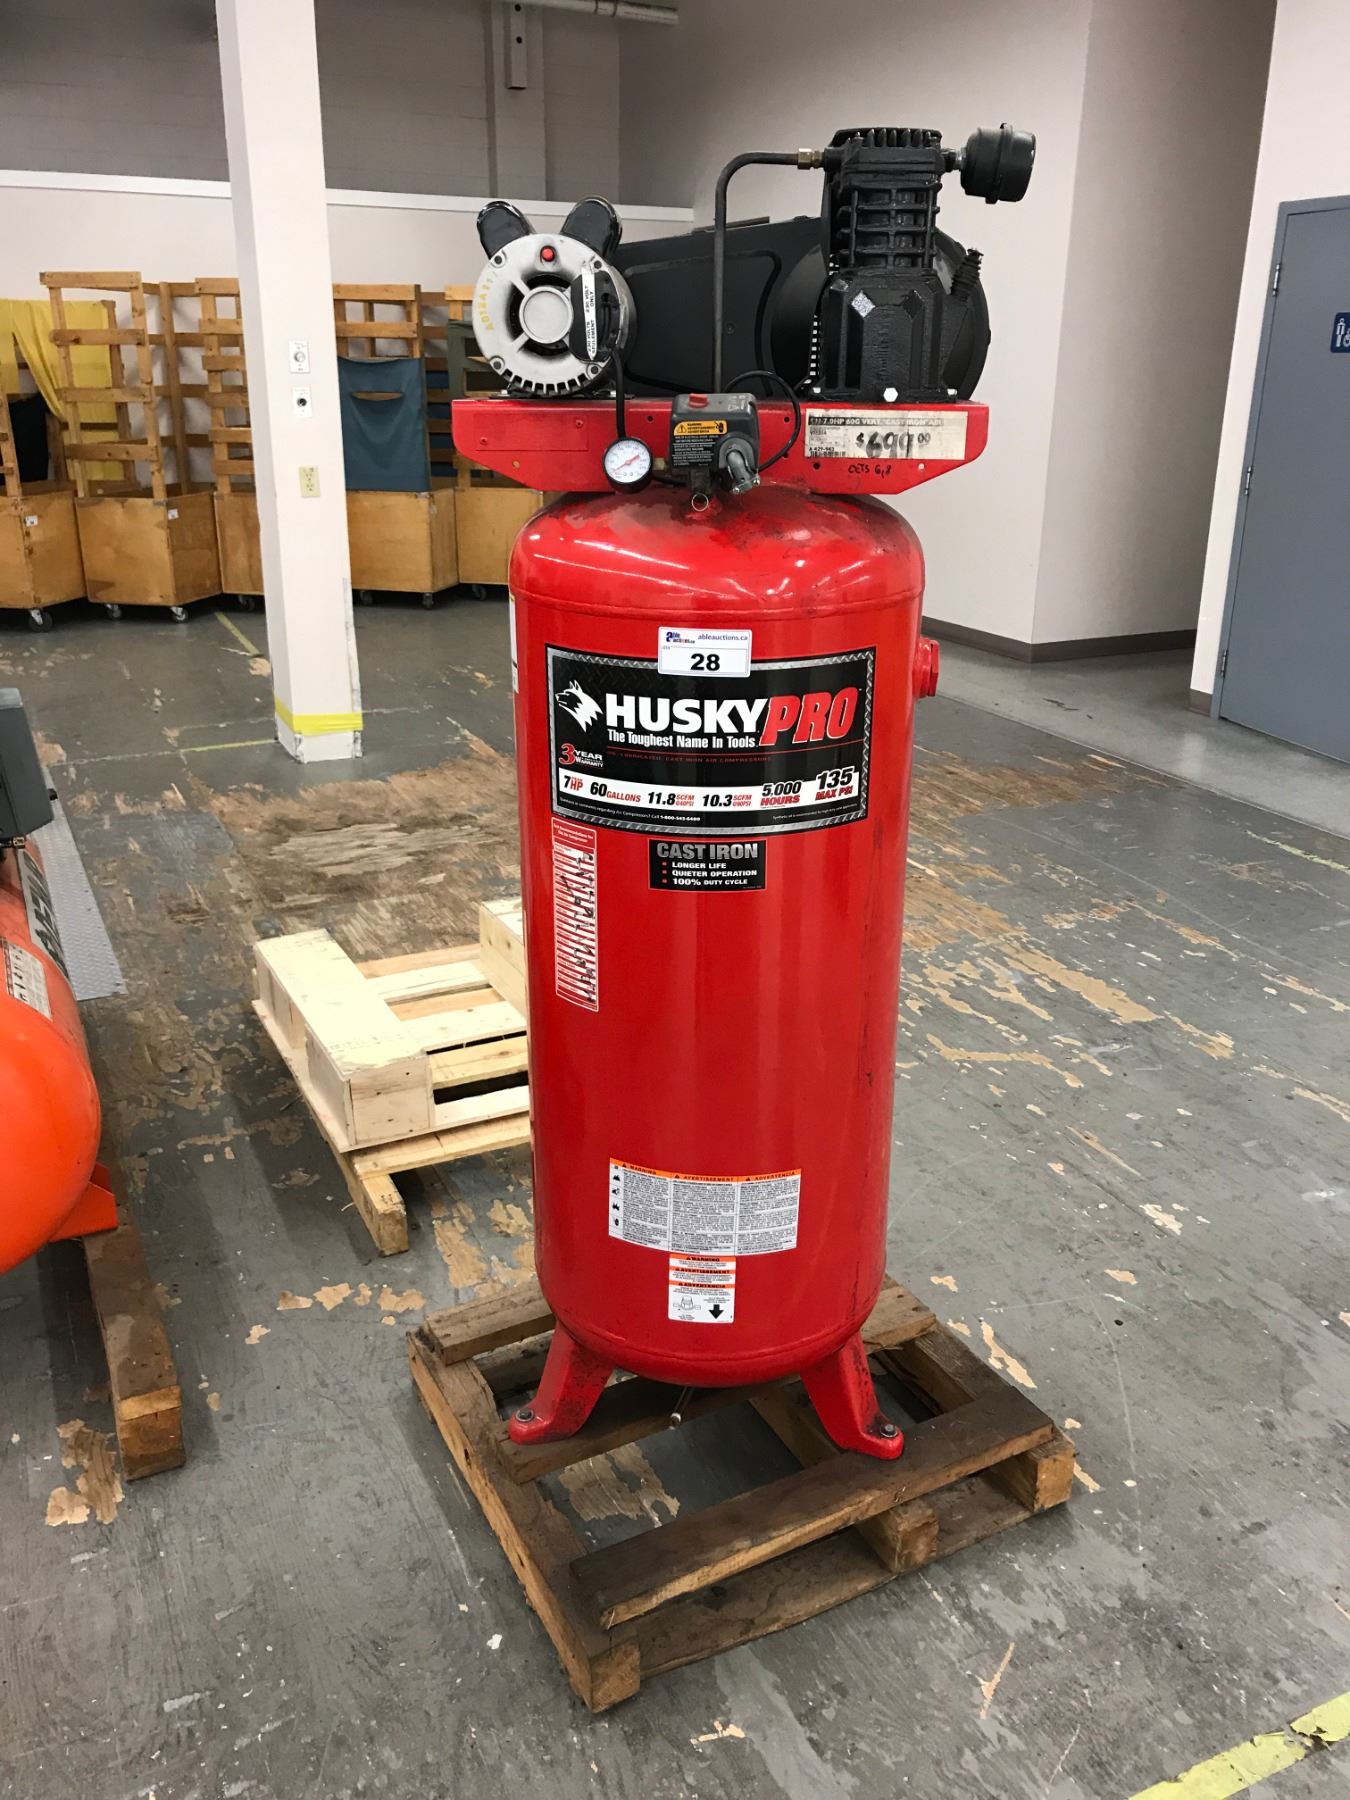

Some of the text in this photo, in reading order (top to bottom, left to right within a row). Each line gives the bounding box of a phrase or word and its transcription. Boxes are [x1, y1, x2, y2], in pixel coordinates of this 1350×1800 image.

[690, 653, 720, 672] 28
[606, 686, 859, 746] HUSKY PRO
[608, 728, 626, 743] The
[627, 731, 674, 748] Toughest
[676, 736, 708, 748] Name
[712, 736, 724, 748] In
[558, 742, 602, 764] 3 YEAR
[575, 756, 604, 768] WARRANTY
[818, 766, 854, 790] 135
[564, 775, 571, 788] 7
[570, 779, 583, 790] HP
[590, 782, 608, 797] 60
[607, 790, 641, 802] GALLONS
[648, 792, 676, 806] 11.8
[702, 794, 732, 807] 10.3
[762, 782, 802, 796] 5,000
[815, 786, 854, 800] MAX PSI
[760, 795, 800, 805] HOURS
[656, 842, 758, 860] CAST IRON
[672, 878, 701, 886] 100%
[630, 1165, 657, 1175] WARNING
[754, 1171, 796, 1182] ADVERTENCIA
